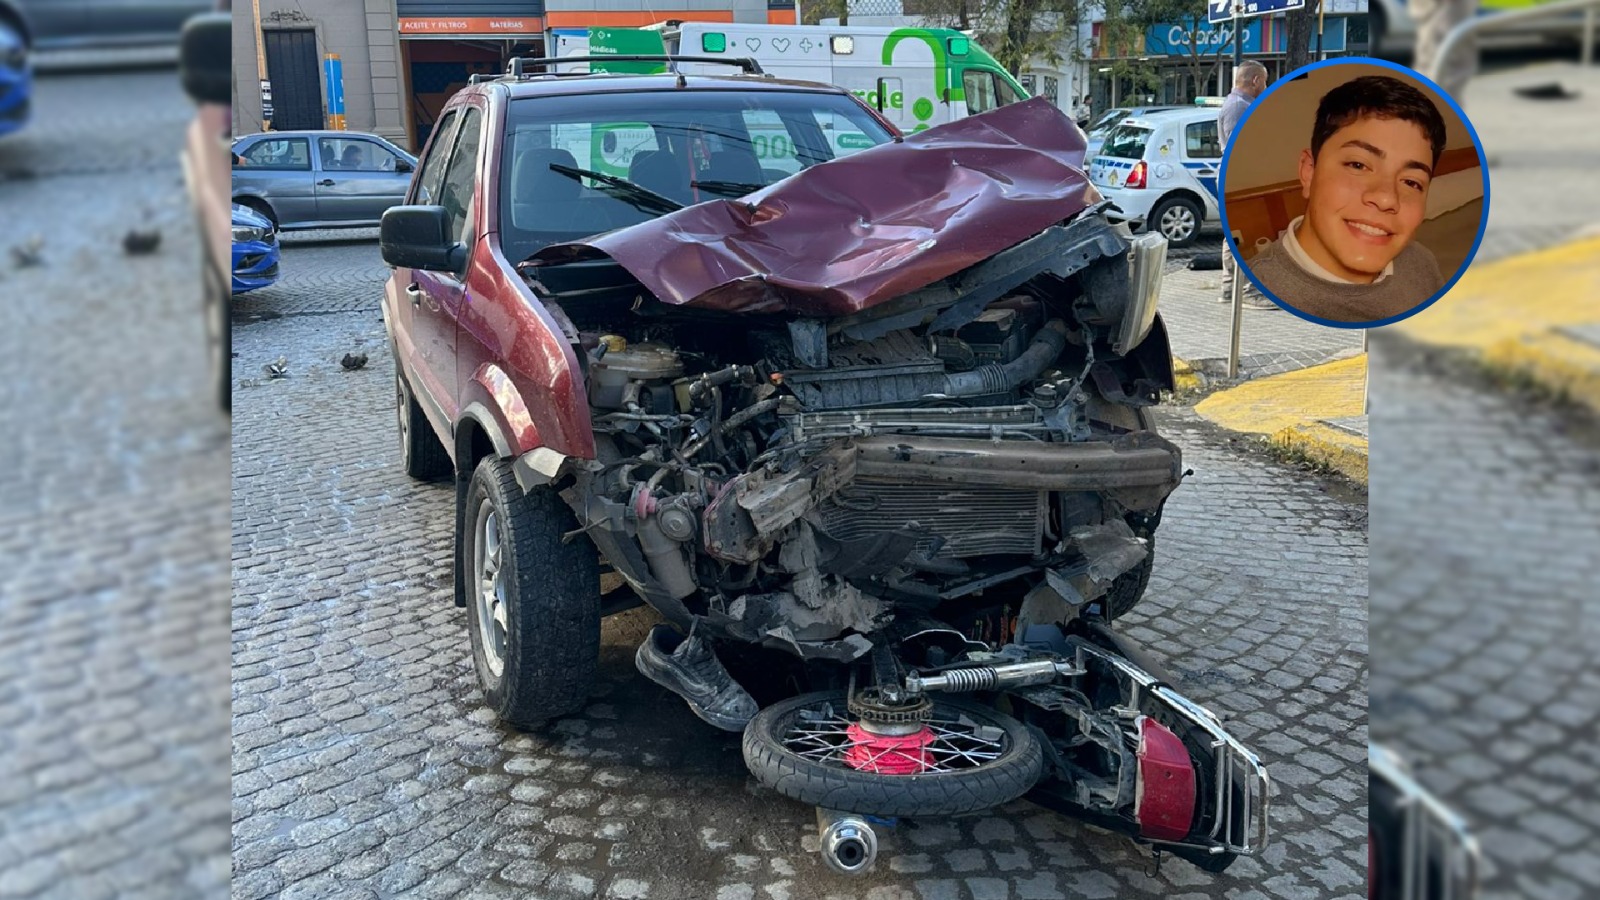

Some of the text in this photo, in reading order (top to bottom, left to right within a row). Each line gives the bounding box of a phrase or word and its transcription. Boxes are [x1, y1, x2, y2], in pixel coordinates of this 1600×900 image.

[404, 21, 468, 29] ACEITE Y FILTROS
